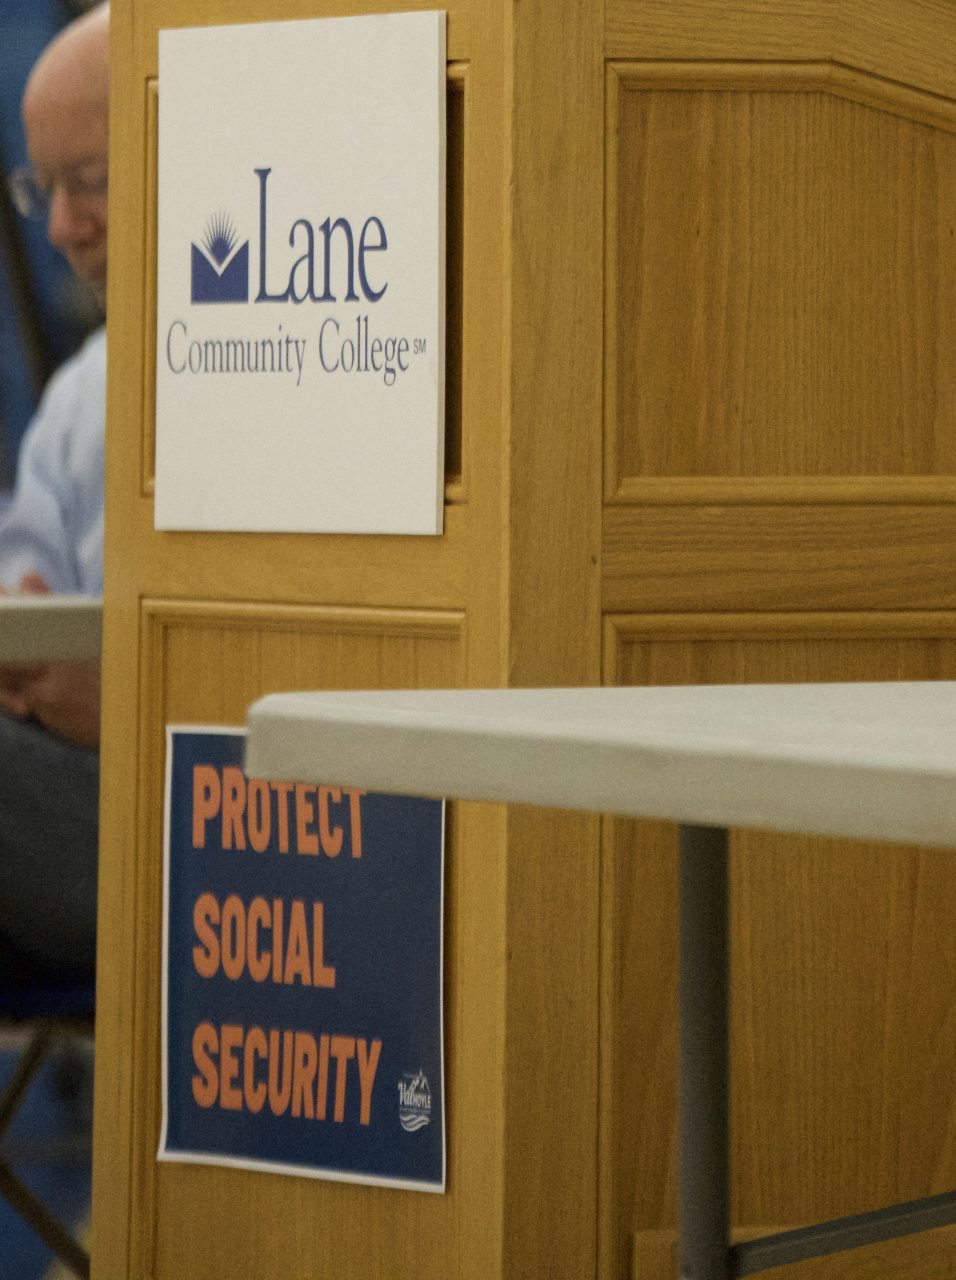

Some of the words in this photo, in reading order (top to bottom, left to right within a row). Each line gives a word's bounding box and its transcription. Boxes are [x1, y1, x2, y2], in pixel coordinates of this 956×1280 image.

[254, 167, 388, 305] Lane
[166, 320, 307, 387] Community
[318, 315, 410, 386] College
[192, 764, 368, 859] PROTECT
[192, 892, 336, 989] SOCIAL
[191, 1021, 382, 1126] SECURITY
